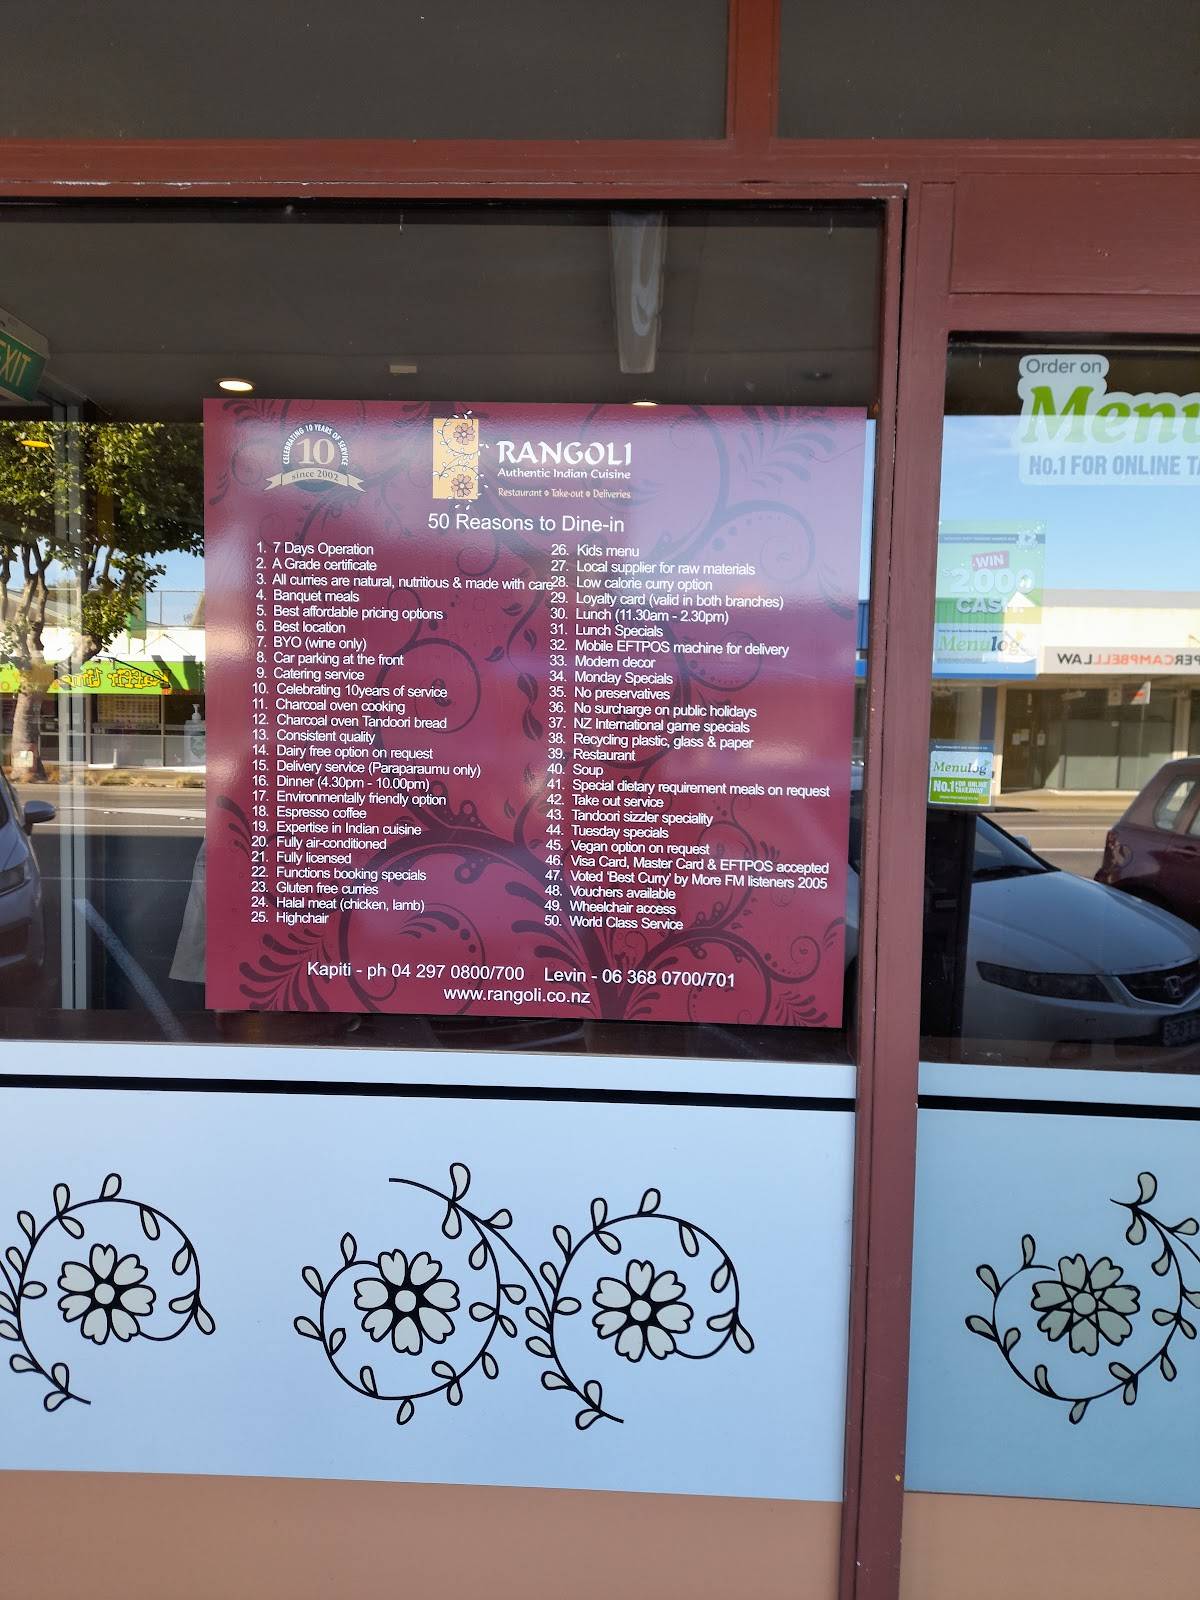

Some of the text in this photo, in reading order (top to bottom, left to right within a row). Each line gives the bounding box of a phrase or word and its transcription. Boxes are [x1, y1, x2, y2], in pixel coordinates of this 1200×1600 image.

[1026, 358, 1102, 374] Order on
[283, 423, 349, 466] CELEBRATING 10 YEARS OF SERVICE
[296, 438, 334, 465] 10
[495, 440, 632, 466] RANGOLI
[497, 467, 631, 480] Authentic Indian Cuisine
[1071, 456, 1107, 476] FOR
[1112, 456, 1181, 476] ONLINE
[291, 470, 338, 481] since 2002
[498, 487, 631, 499] Restaurant Take-out Deliveries
[427, 513, 625, 532] 50 Reasons to Dine-in
[257, 541, 374, 557] 1. 7 Days Operation
[551, 544, 639, 557] 26. Kids menu
[256, 557, 378, 571] 2. A Grade certificate
[974, 554, 1004, 569] WIN
[256, 572, 552, 590] 3. All curries are natural, nutritious & made with care
[550, 591, 784, 610] 29. Loyalty card (valid in both branches)
[256, 604, 444, 622] 5. Best affordable pricing options
[550, 607, 568, 619] 30.
[576, 607, 614, 620] Lunch
[614, 608, 669, 624] (11.30am
[680, 610, 729, 625] 2.30pm)
[549, 639, 789, 658] 32. Mobile EFTPOS machine for delivery
[939, 634, 1022, 657] Menulog
[256, 651, 404, 667] 8. Car parking at the front
[548, 701, 757, 720] 36. No surcharge on public holidays
[252, 713, 447, 729] 12. Charcoal oven Tandoori bread
[252, 759, 481, 778] 15. Delivery service (Paraparaumu only)
[934, 760, 987, 776] Menulog
[252, 774, 269, 786] 16.
[276, 774, 316, 787] Dinner
[318, 775, 366, 791] (4.30pm
[373, 777, 430, 792] 10.00pm)
[547, 777, 830, 799] 41. Special dietary requirement meals on request
[252, 820, 422, 836] 19. Expertise in Indian cuisine
[545, 853, 829, 876] 46. Visa Card, Master Card & EFTPOS accepted
[251, 895, 425, 913] 24. Halal meat (chicken, lamb)
[251, 910, 329, 926] 25. Highchair
[544, 914, 684, 930] 50. World Class Service
[307, 961, 351, 980] Kapiti
[367, 963, 386, 980] ph
[391, 963, 411, 978] 04
[416, 963, 445, 979] 297
[451, 965, 525, 981] 0800/700
[544, 967, 587, 983] Levin
[602, 969, 622, 984] 06
[627, 969, 657, 985] 368
[661, 969, 736, 987] 0700/701
[443, 987, 591, 1007] www.rangoli.co.nz
